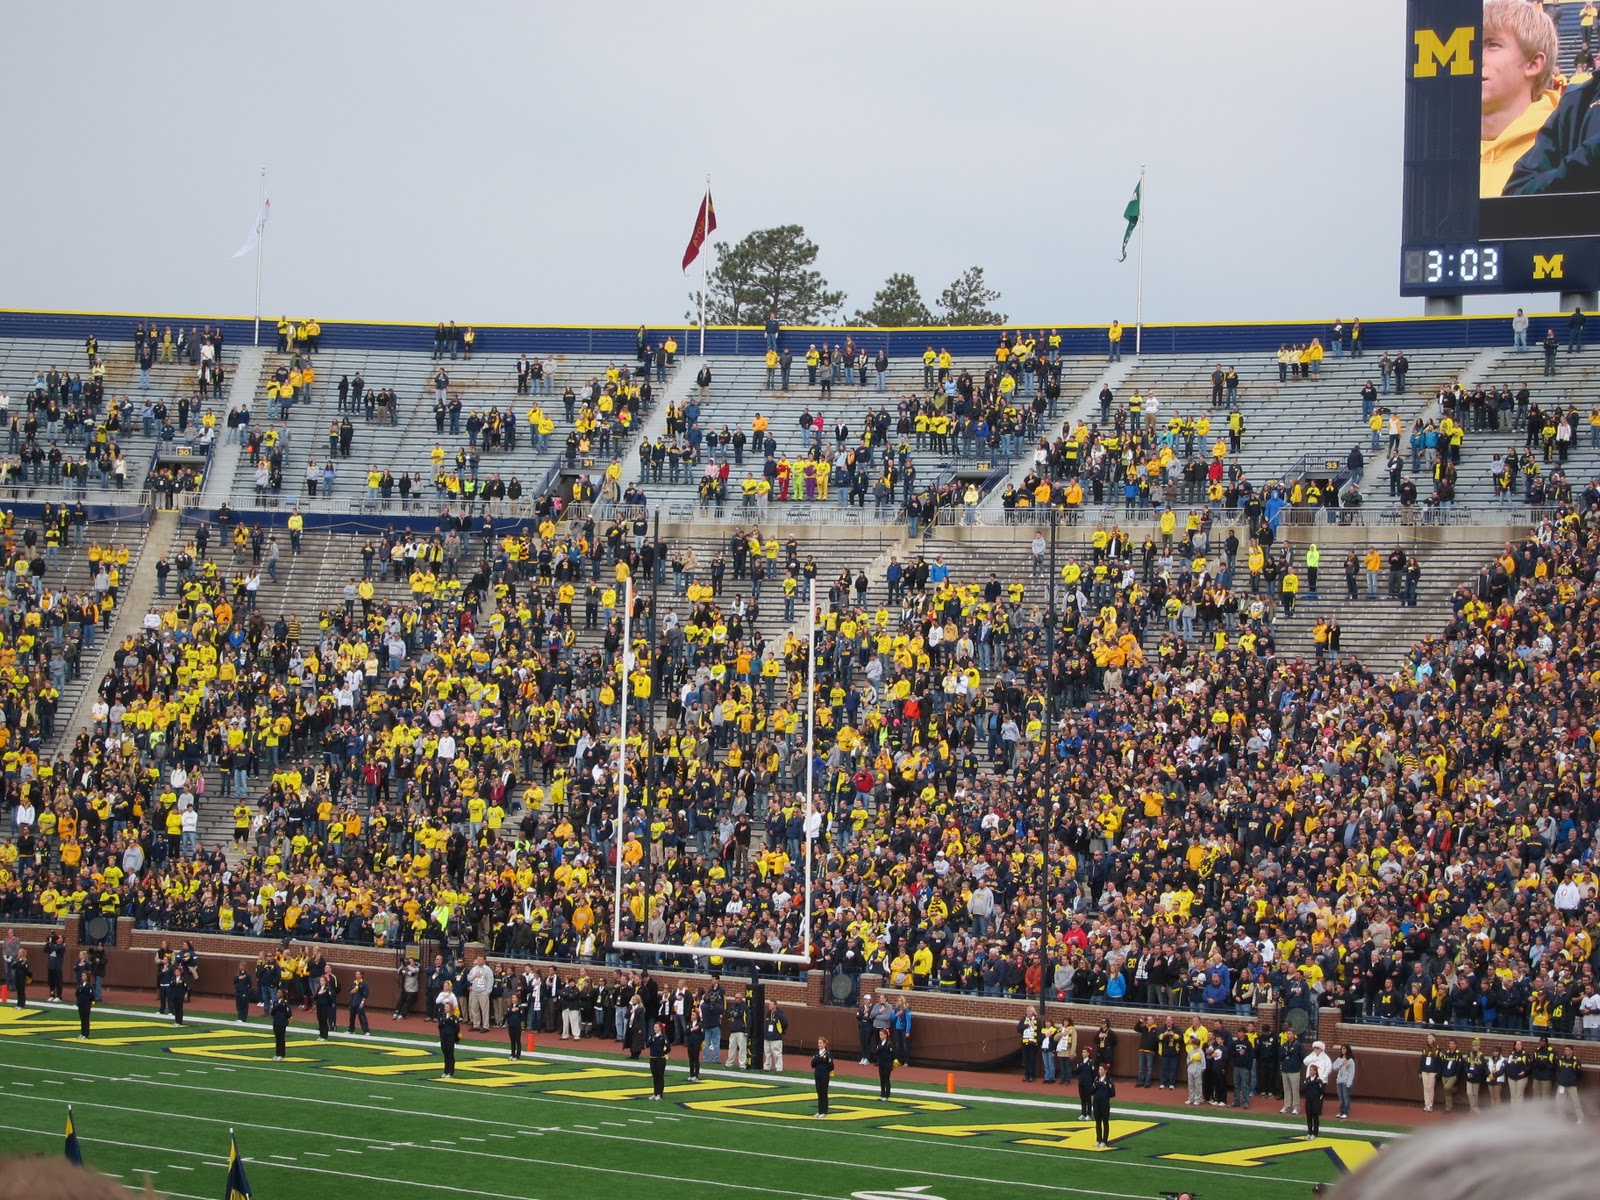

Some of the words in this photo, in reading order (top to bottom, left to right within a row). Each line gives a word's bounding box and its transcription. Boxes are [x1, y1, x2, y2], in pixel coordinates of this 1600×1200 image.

[1413, 27, 1475, 78] M
[1427, 248, 1498, 282] 3:03
[1532, 254, 1564, 279] M
[317, 674, 326, 682] 20
[1382, 995, 1392, 1004] M
